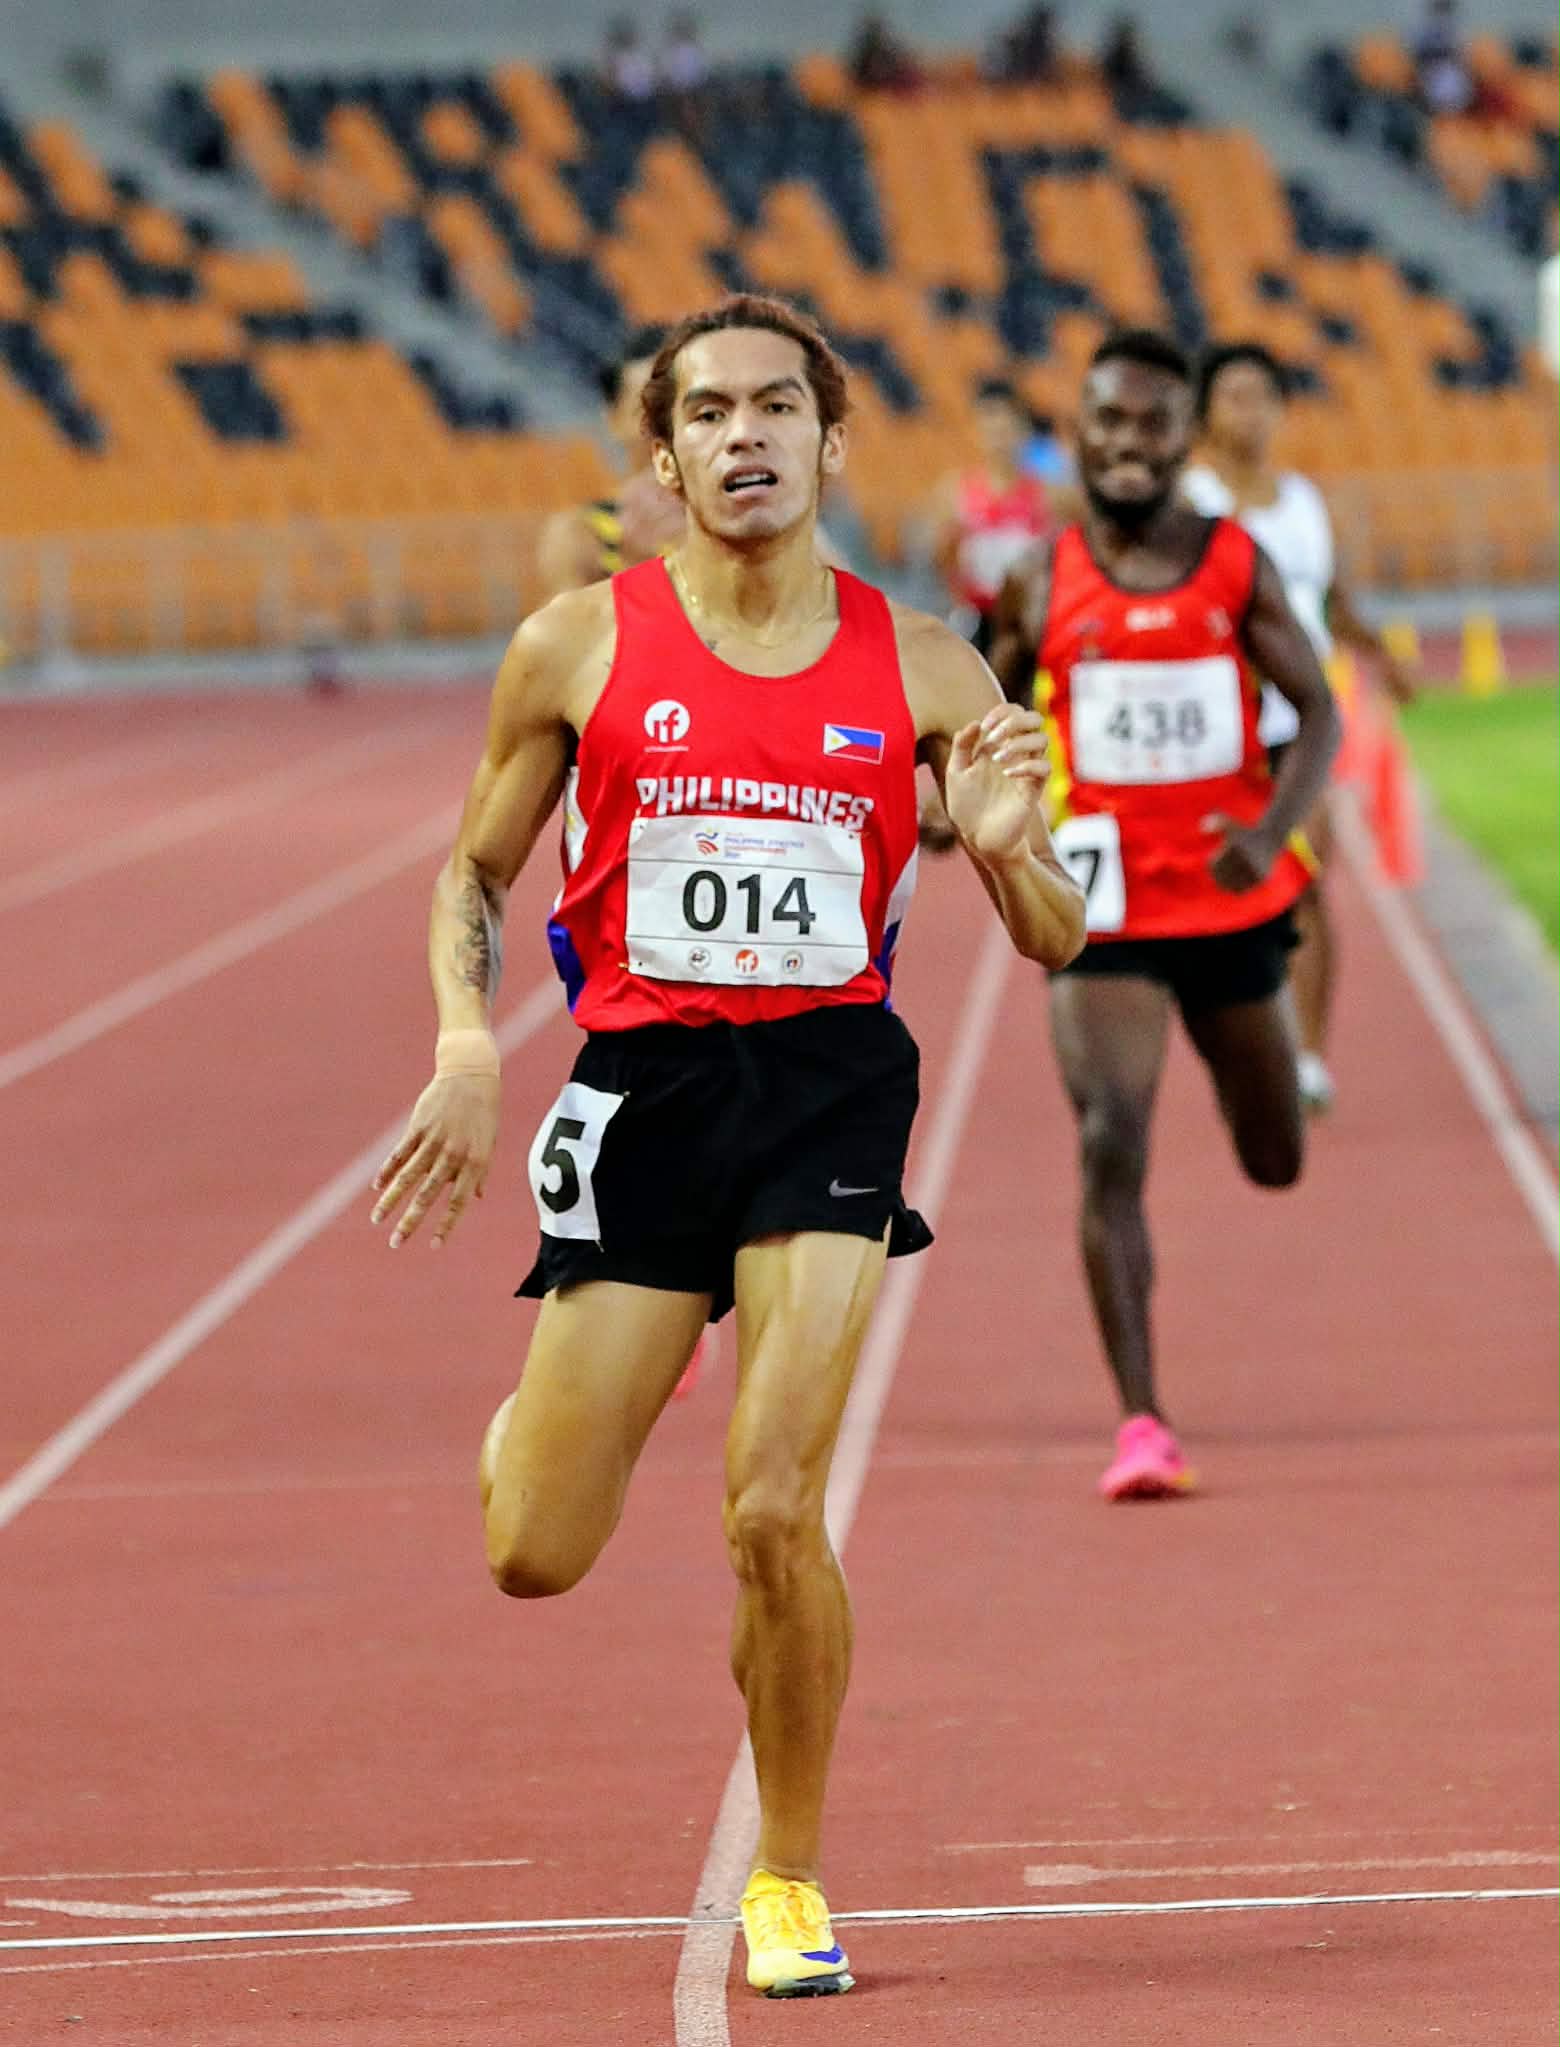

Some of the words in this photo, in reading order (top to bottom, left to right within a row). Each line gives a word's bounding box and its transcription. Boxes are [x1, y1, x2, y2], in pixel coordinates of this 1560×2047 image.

[637, 777, 874, 829] PHILIPPINES
[1068, 848, 1100, 895] 7
[683, 870, 815, 935] 014
[540, 1117, 586, 1214] 5
